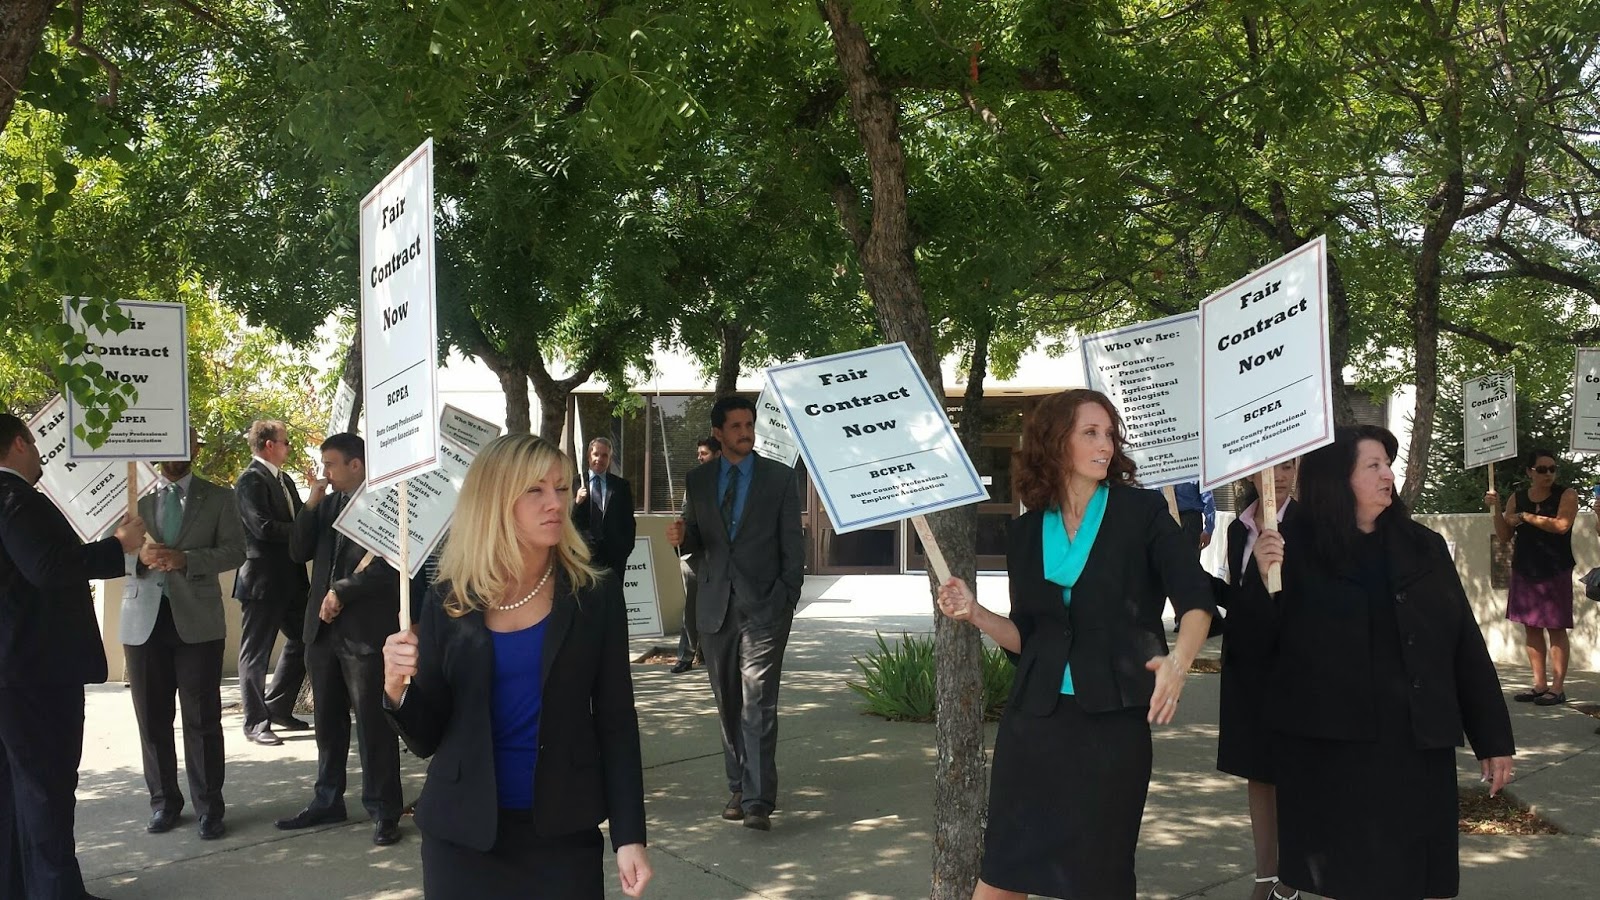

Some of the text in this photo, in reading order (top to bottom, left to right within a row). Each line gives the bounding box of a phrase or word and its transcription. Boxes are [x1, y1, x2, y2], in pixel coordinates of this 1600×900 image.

[382, 197, 406, 230] Fair
[371, 234, 421, 288] Contract
[1240, 279, 1282, 310] Fair
[383, 301, 409, 331] Now
[1217, 297, 1308, 351] Contract
[1104, 331, 1180, 352] Who We Are:
[1099, 363, 1121, 372] Your
[1122, 356, 1155, 367] County
[1238, 344, 1285, 375] Now
[105, 370, 149, 383] Now
[818, 368, 869, 386] Fair
[1118, 361, 1175, 377] Prosecutors
[1120, 375, 1152, 386] Nurses
[1121, 378, 1179, 396] Agricultural
[387, 385, 409, 406] BCPEA
[804, 386, 911, 417] Contract
[1123, 390, 1170, 404] Biologists
[1471, 392, 1508, 408] Contract
[1124, 401, 1160, 412] Doctors
[1125, 409, 1166, 421] Physical
[1243, 400, 1283, 423] BCPEA
[1480, 410, 1499, 420] Now
[37, 411, 66, 437] Fair
[454, 415, 467, 424] Who
[468, 421, 476, 429] We
[769, 418, 788, 431] Now
[842, 419, 897, 438] Now
[1127, 416, 1178, 430] Therapists
[1222, 409, 1307, 449] Butte County Professional
[1128, 426, 1176, 440] Architects
[1130, 431, 1199, 449] Microbiologist
[1229, 422, 1300, 455] Employee Association
[441, 445, 470, 468] We Are:
[1148, 453, 1174, 461] BCPEA
[869, 462, 916, 478] BCPEA
[1139, 462, 1162, 470] County
[1161, 463, 1198, 473] Association
[91, 473, 115, 495] BCPEA
[411, 476, 442, 496] icultural
[850, 473, 949, 499] Butte County Professional
[861, 482, 945, 504] Employee Association
[378, 526, 395, 539] BCPEA
